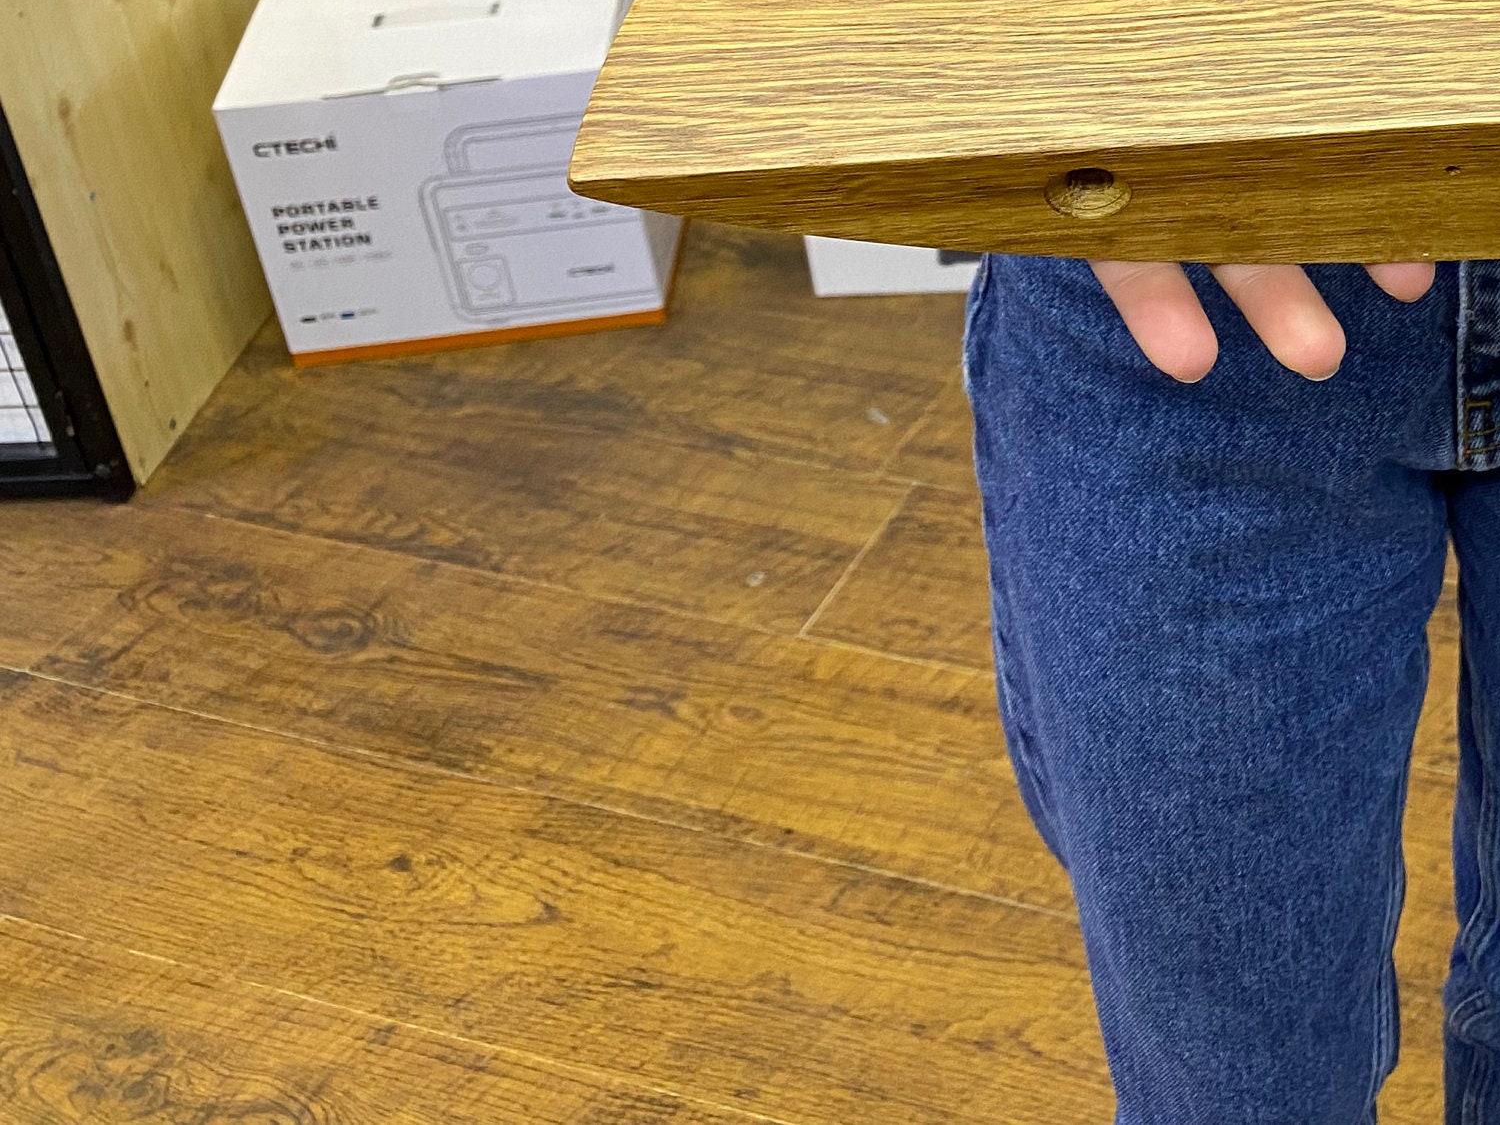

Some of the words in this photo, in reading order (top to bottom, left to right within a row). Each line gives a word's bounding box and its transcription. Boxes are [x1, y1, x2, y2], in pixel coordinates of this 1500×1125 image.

[271, 196, 380, 218] PORTABLE
[276, 217, 355, 236] POWER
[282, 234, 371, 254] STATION
